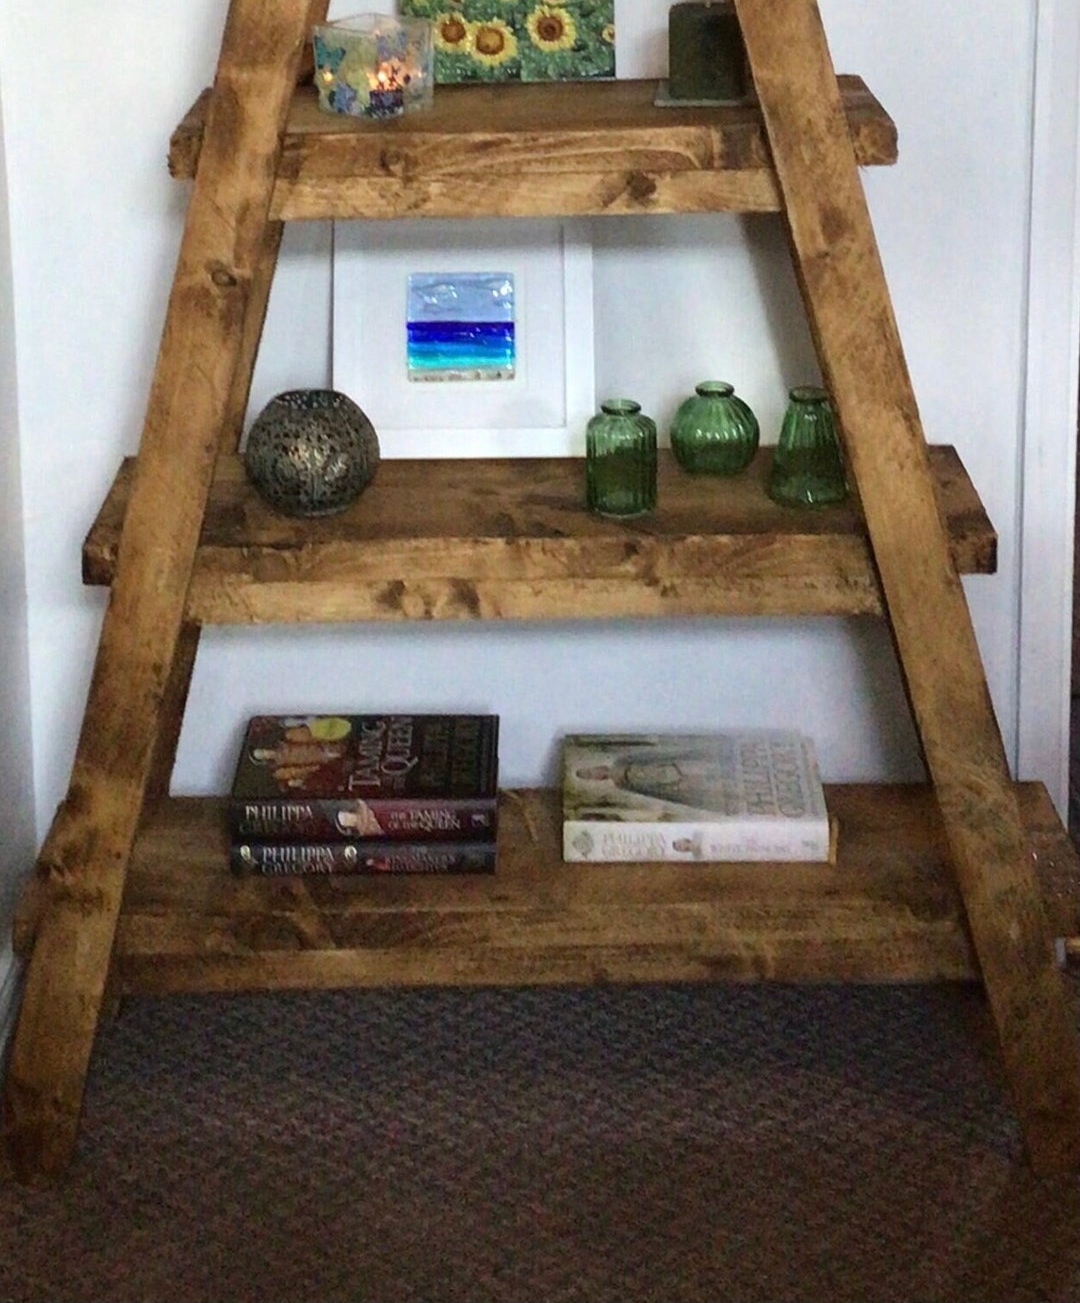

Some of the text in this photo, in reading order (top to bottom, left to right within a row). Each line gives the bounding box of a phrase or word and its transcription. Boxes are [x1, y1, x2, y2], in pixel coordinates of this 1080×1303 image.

[348, 720, 386, 792] TAMING
[245, 805, 314, 821] PHILIPPA
[262, 846, 335, 863] PHILIPPA
